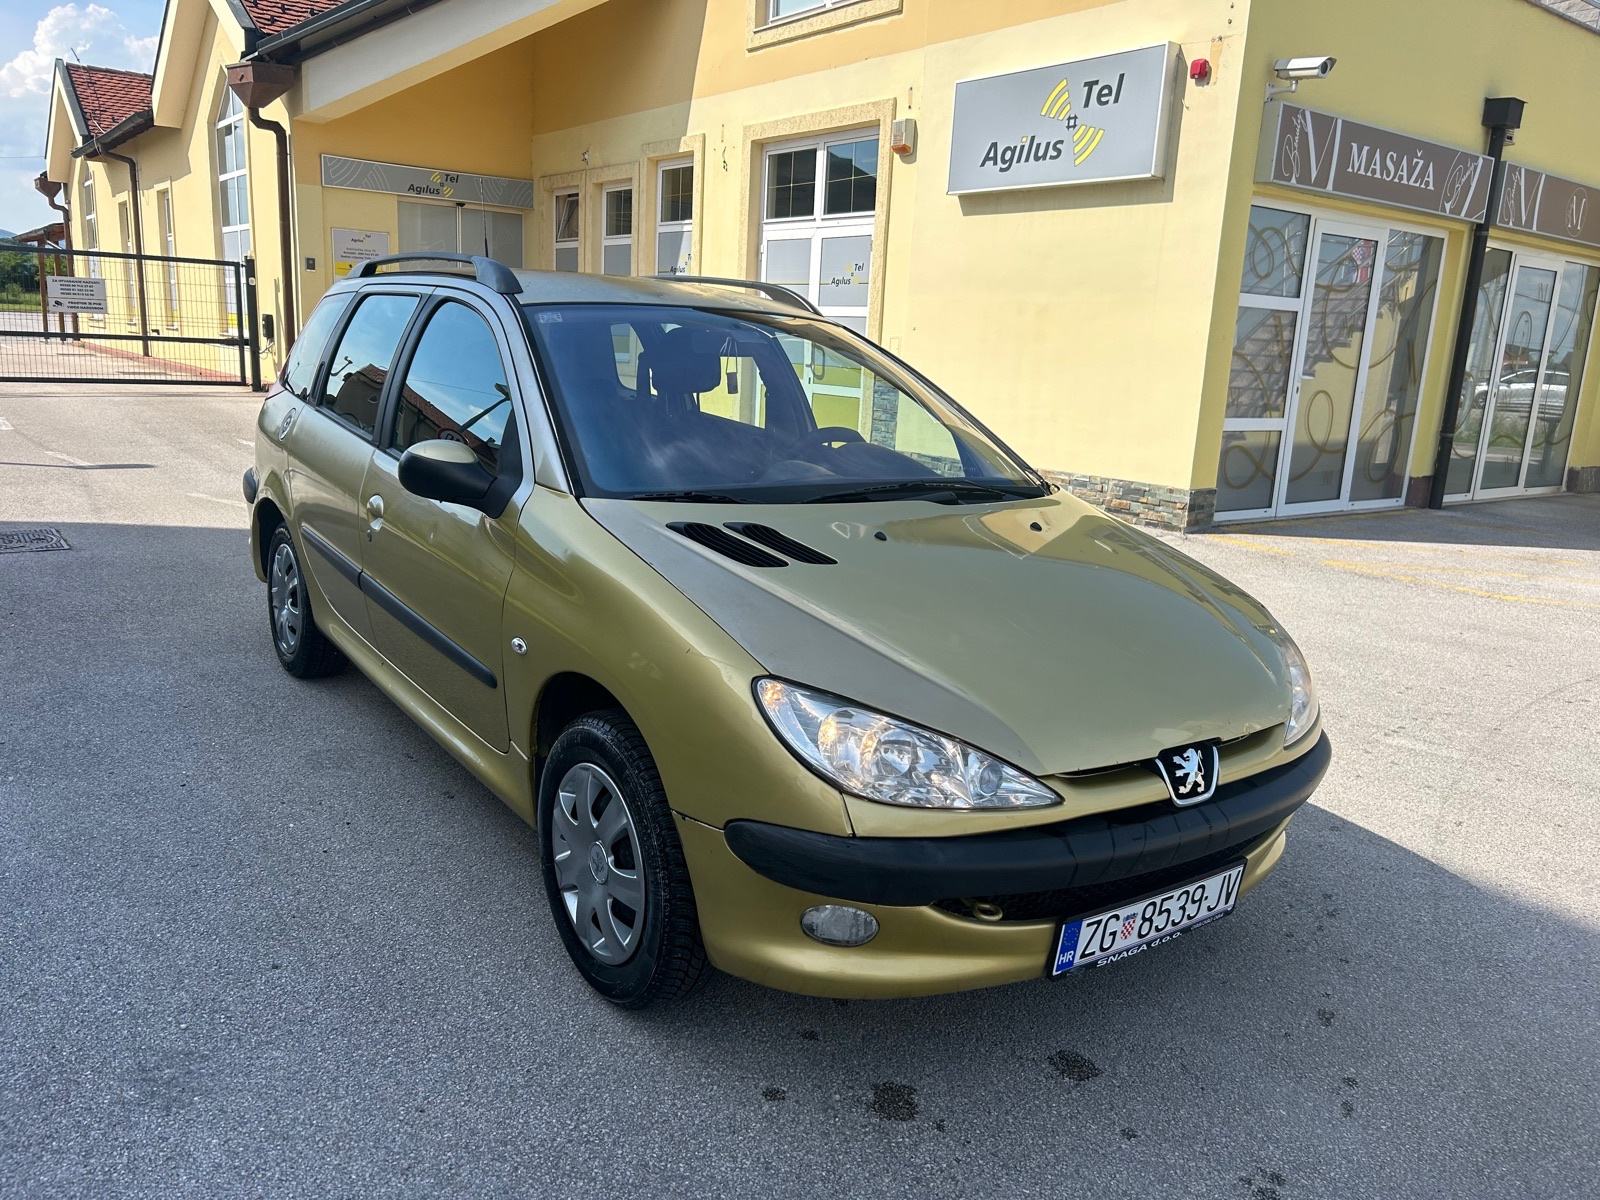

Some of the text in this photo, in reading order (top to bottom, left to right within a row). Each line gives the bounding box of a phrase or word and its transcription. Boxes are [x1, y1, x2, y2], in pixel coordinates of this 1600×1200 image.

[1083, 73, 1126, 109] Tel
[980, 134, 1065, 173] Agilus
[1346, 142, 1435, 191] MASAŽA
[444, 174, 459, 184] Tel
[407, 183, 440, 196] Agilus
[854, 262, 865, 272] Tel
[831, 276, 851, 288] Agilus
[1079, 869, 1242, 960] ZG 8539-JV
[1058, 950, 1075, 965] HR
[1096, 944, 1148, 968] SNAGA
